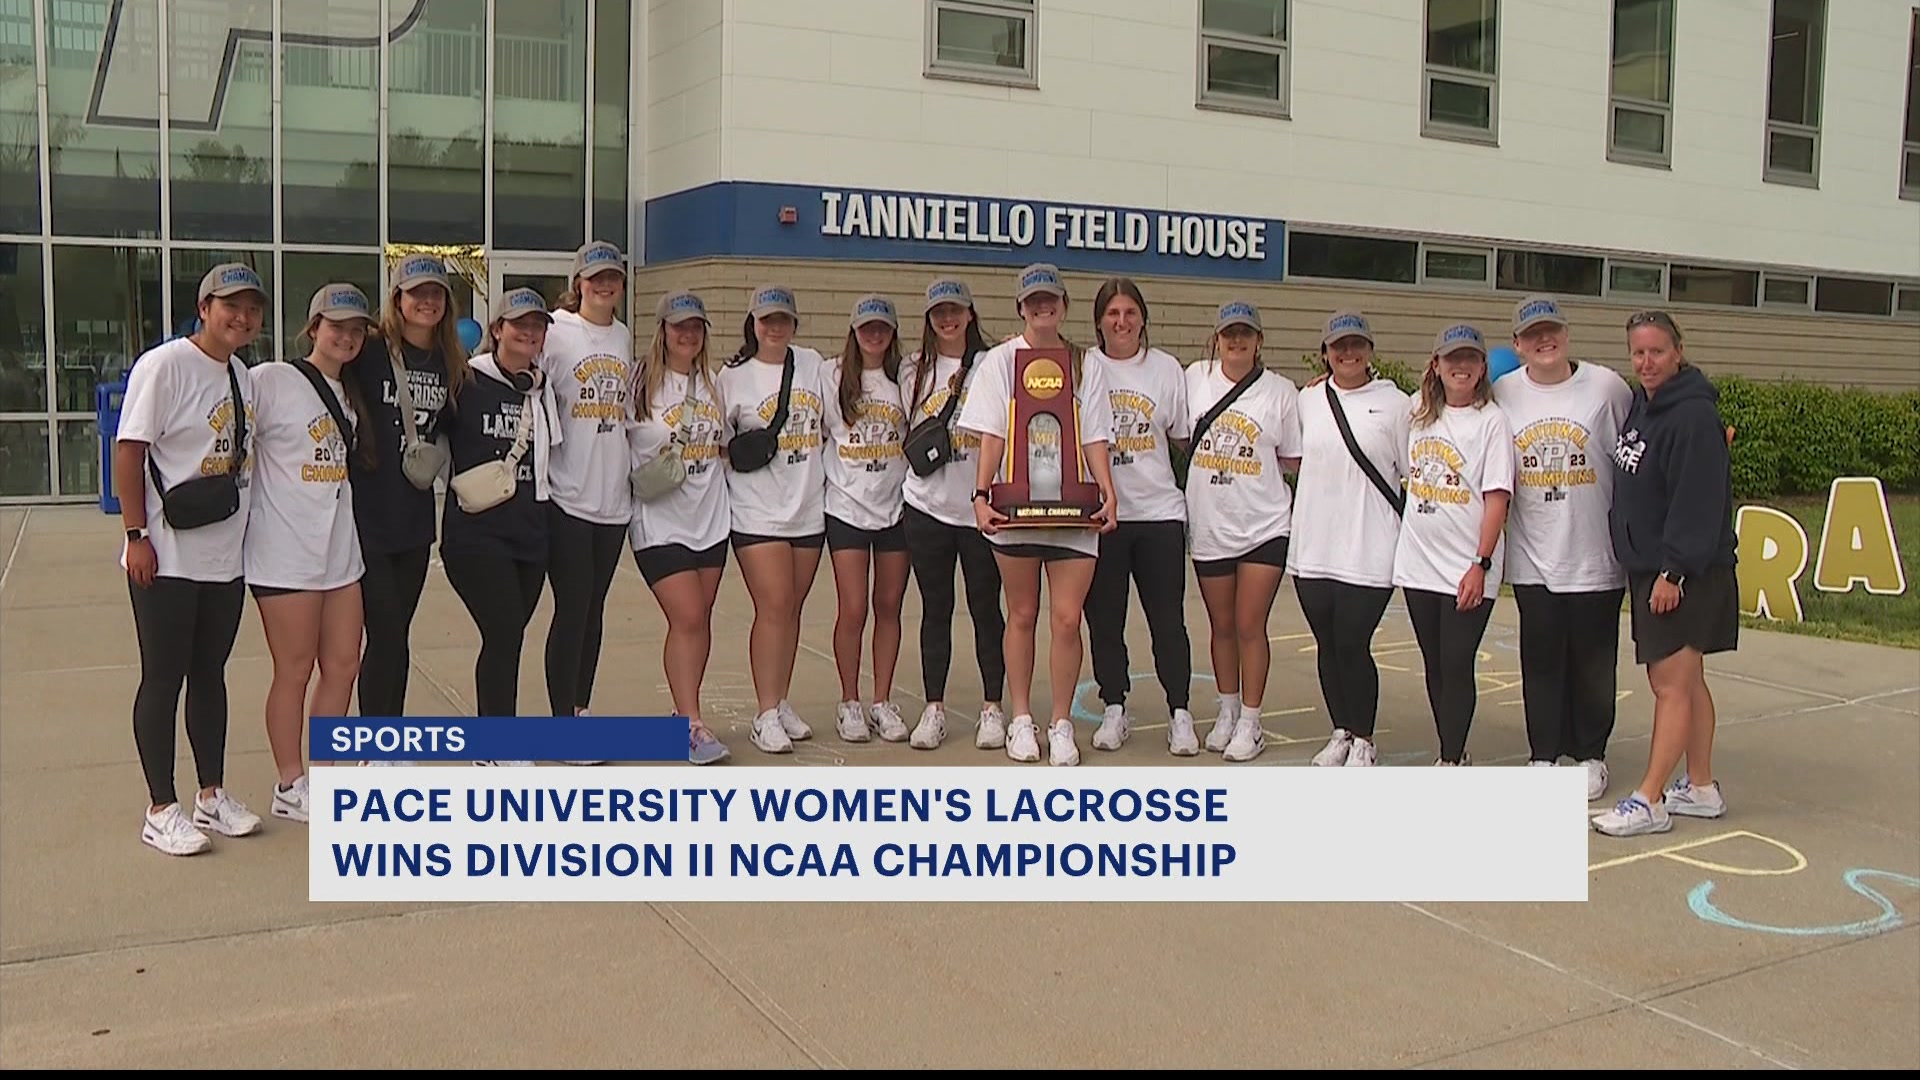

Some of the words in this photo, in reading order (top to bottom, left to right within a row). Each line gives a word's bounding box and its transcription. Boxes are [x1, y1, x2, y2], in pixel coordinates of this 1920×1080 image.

[820, 191, 1035, 247] IANNIELLO
[1045, 206, 1150, 253] FIELD
[1157, 215, 1266, 260] HOUSE
[1027, 378, 1063, 389] NCAA
[580, 387, 595, 399] 20
[1514, 422, 1589, 452] NATIONAL
[215, 439, 229, 453] 20
[1239, 446, 1254, 457] 23
[315, 448, 330, 461] 20
[1523, 456, 1537, 468] 20
[1570, 454, 1586, 466] 23
[1446, 474, 1460, 486] 23
[1016, 508, 1047, 516] NATIONAL
[1048, 509, 1082, 517] CHAMPION
